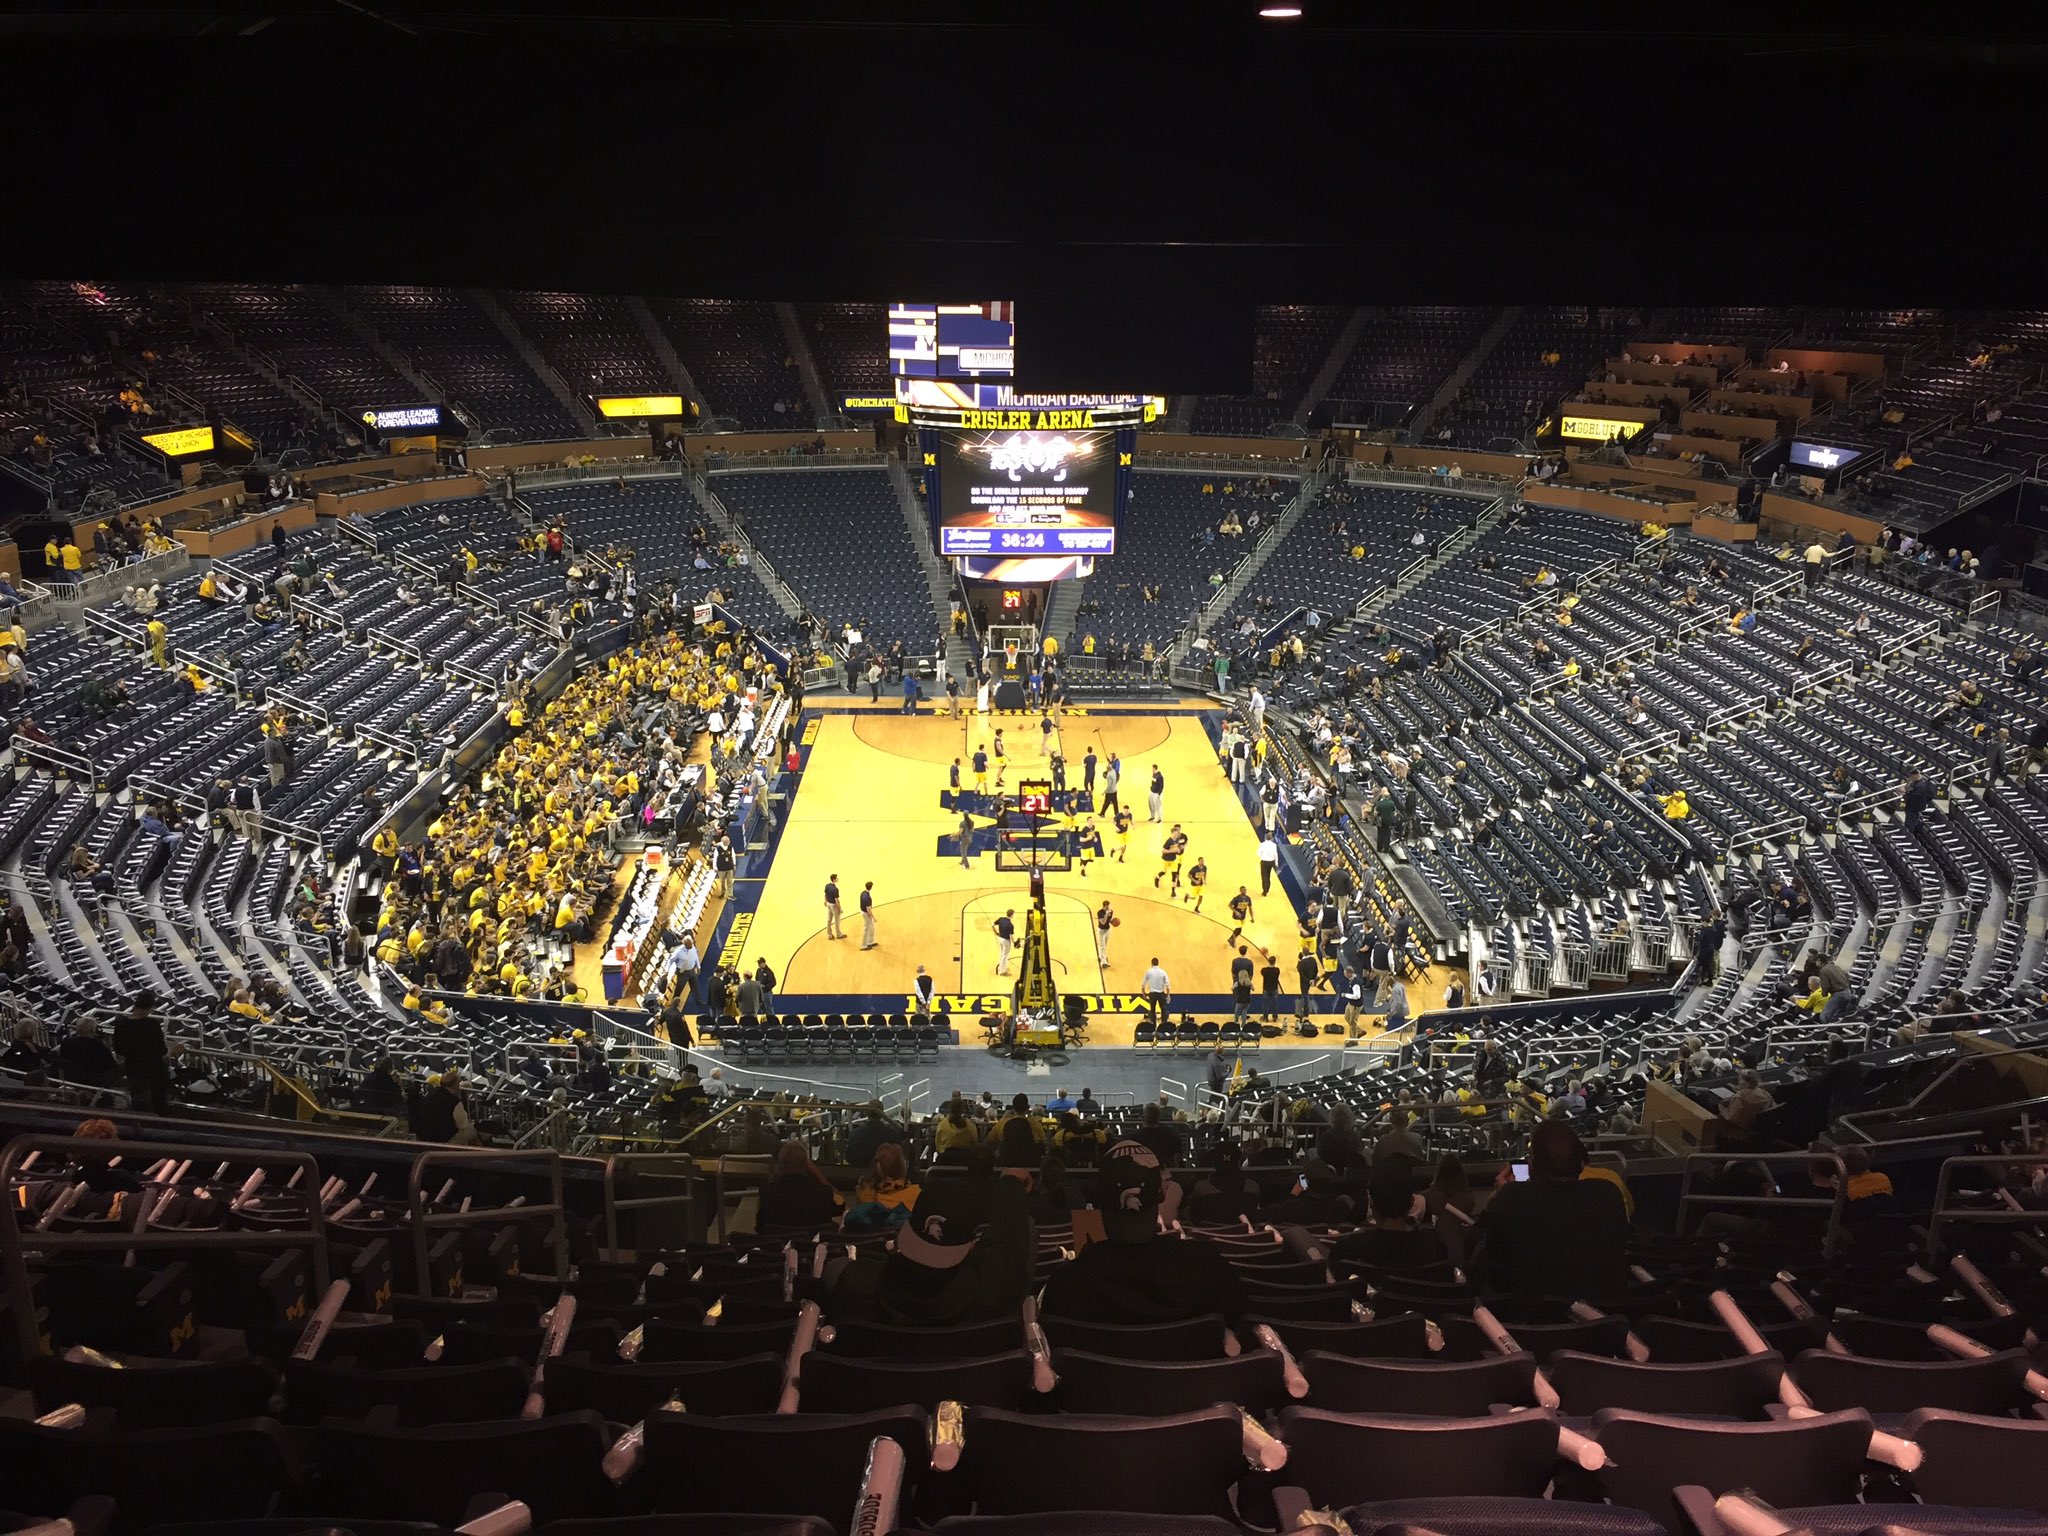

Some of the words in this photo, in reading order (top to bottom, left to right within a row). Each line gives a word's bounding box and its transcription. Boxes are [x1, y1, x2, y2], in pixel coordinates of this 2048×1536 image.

[378, 411, 406, 421] ALWAYS
[961, 410, 1031, 429] CRISLER
[1036, 410, 1095, 429] ARENA
[378, 418, 409, 428] FOREVER
[1564, 421, 1576, 433] M
[924, 453, 936, 466] M
[1119, 452, 1132, 466] M
[1005, 597, 1019, 607] 27
[1025, 795, 1046, 812] 27
[904, 995, 1163, 1014] MICGAN
